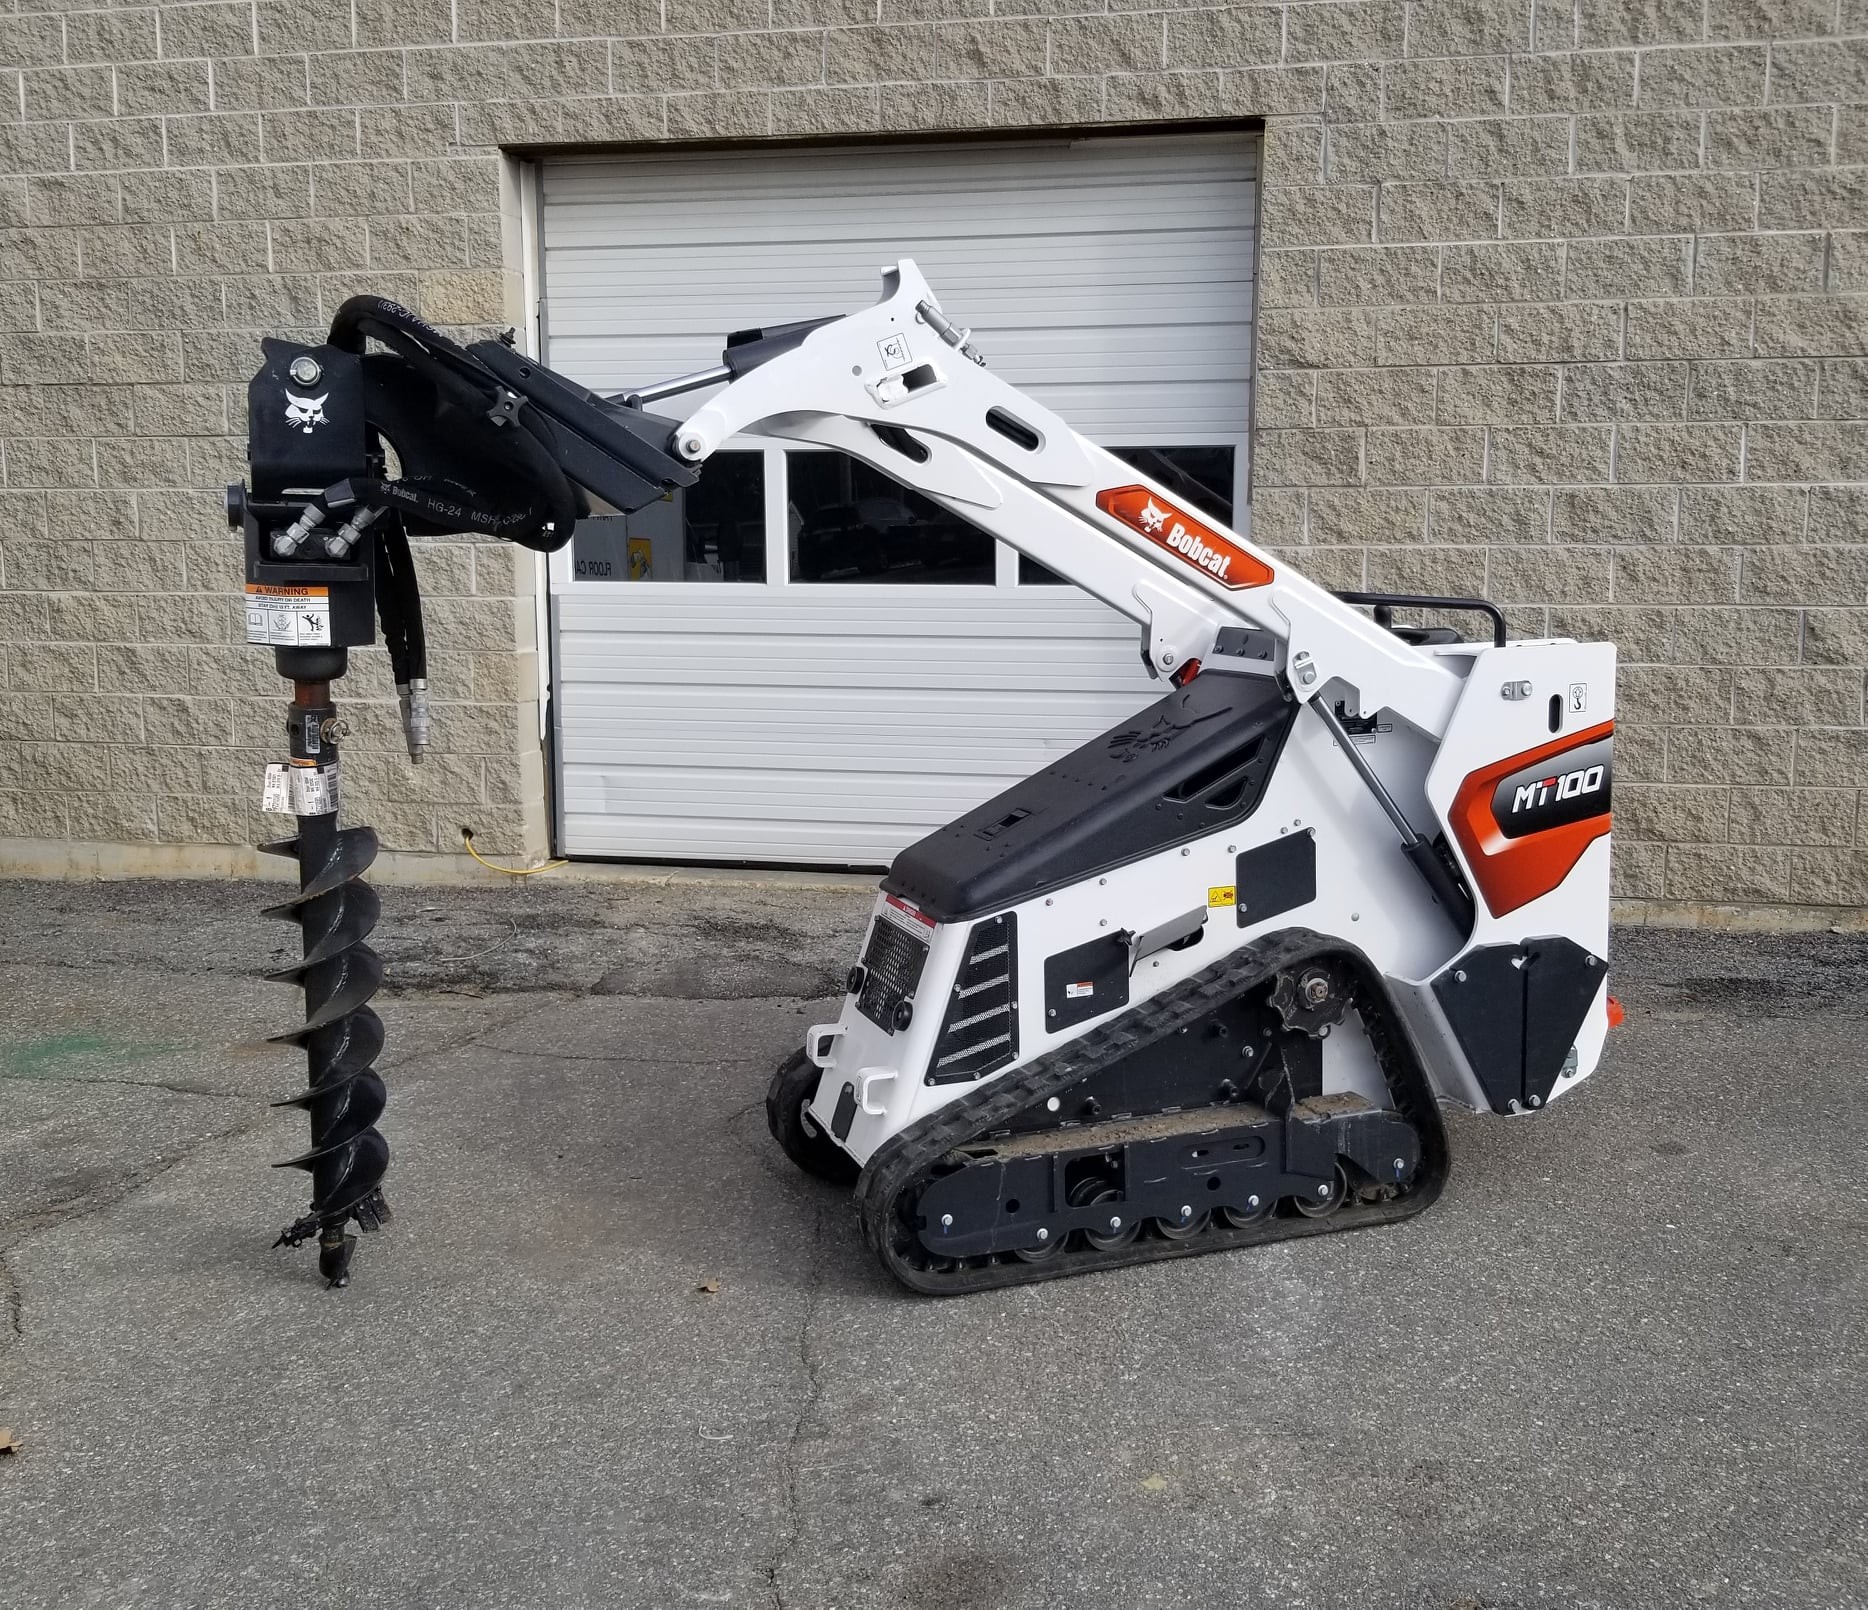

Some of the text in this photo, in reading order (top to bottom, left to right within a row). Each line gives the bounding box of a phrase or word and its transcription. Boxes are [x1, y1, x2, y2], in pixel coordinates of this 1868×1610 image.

[427, 498, 462, 517] HG-24
[1166, 522, 1231, 579] Bobcat
[265, 586, 309, 596] WARNING
[1511, 764, 1605, 814] MT100
